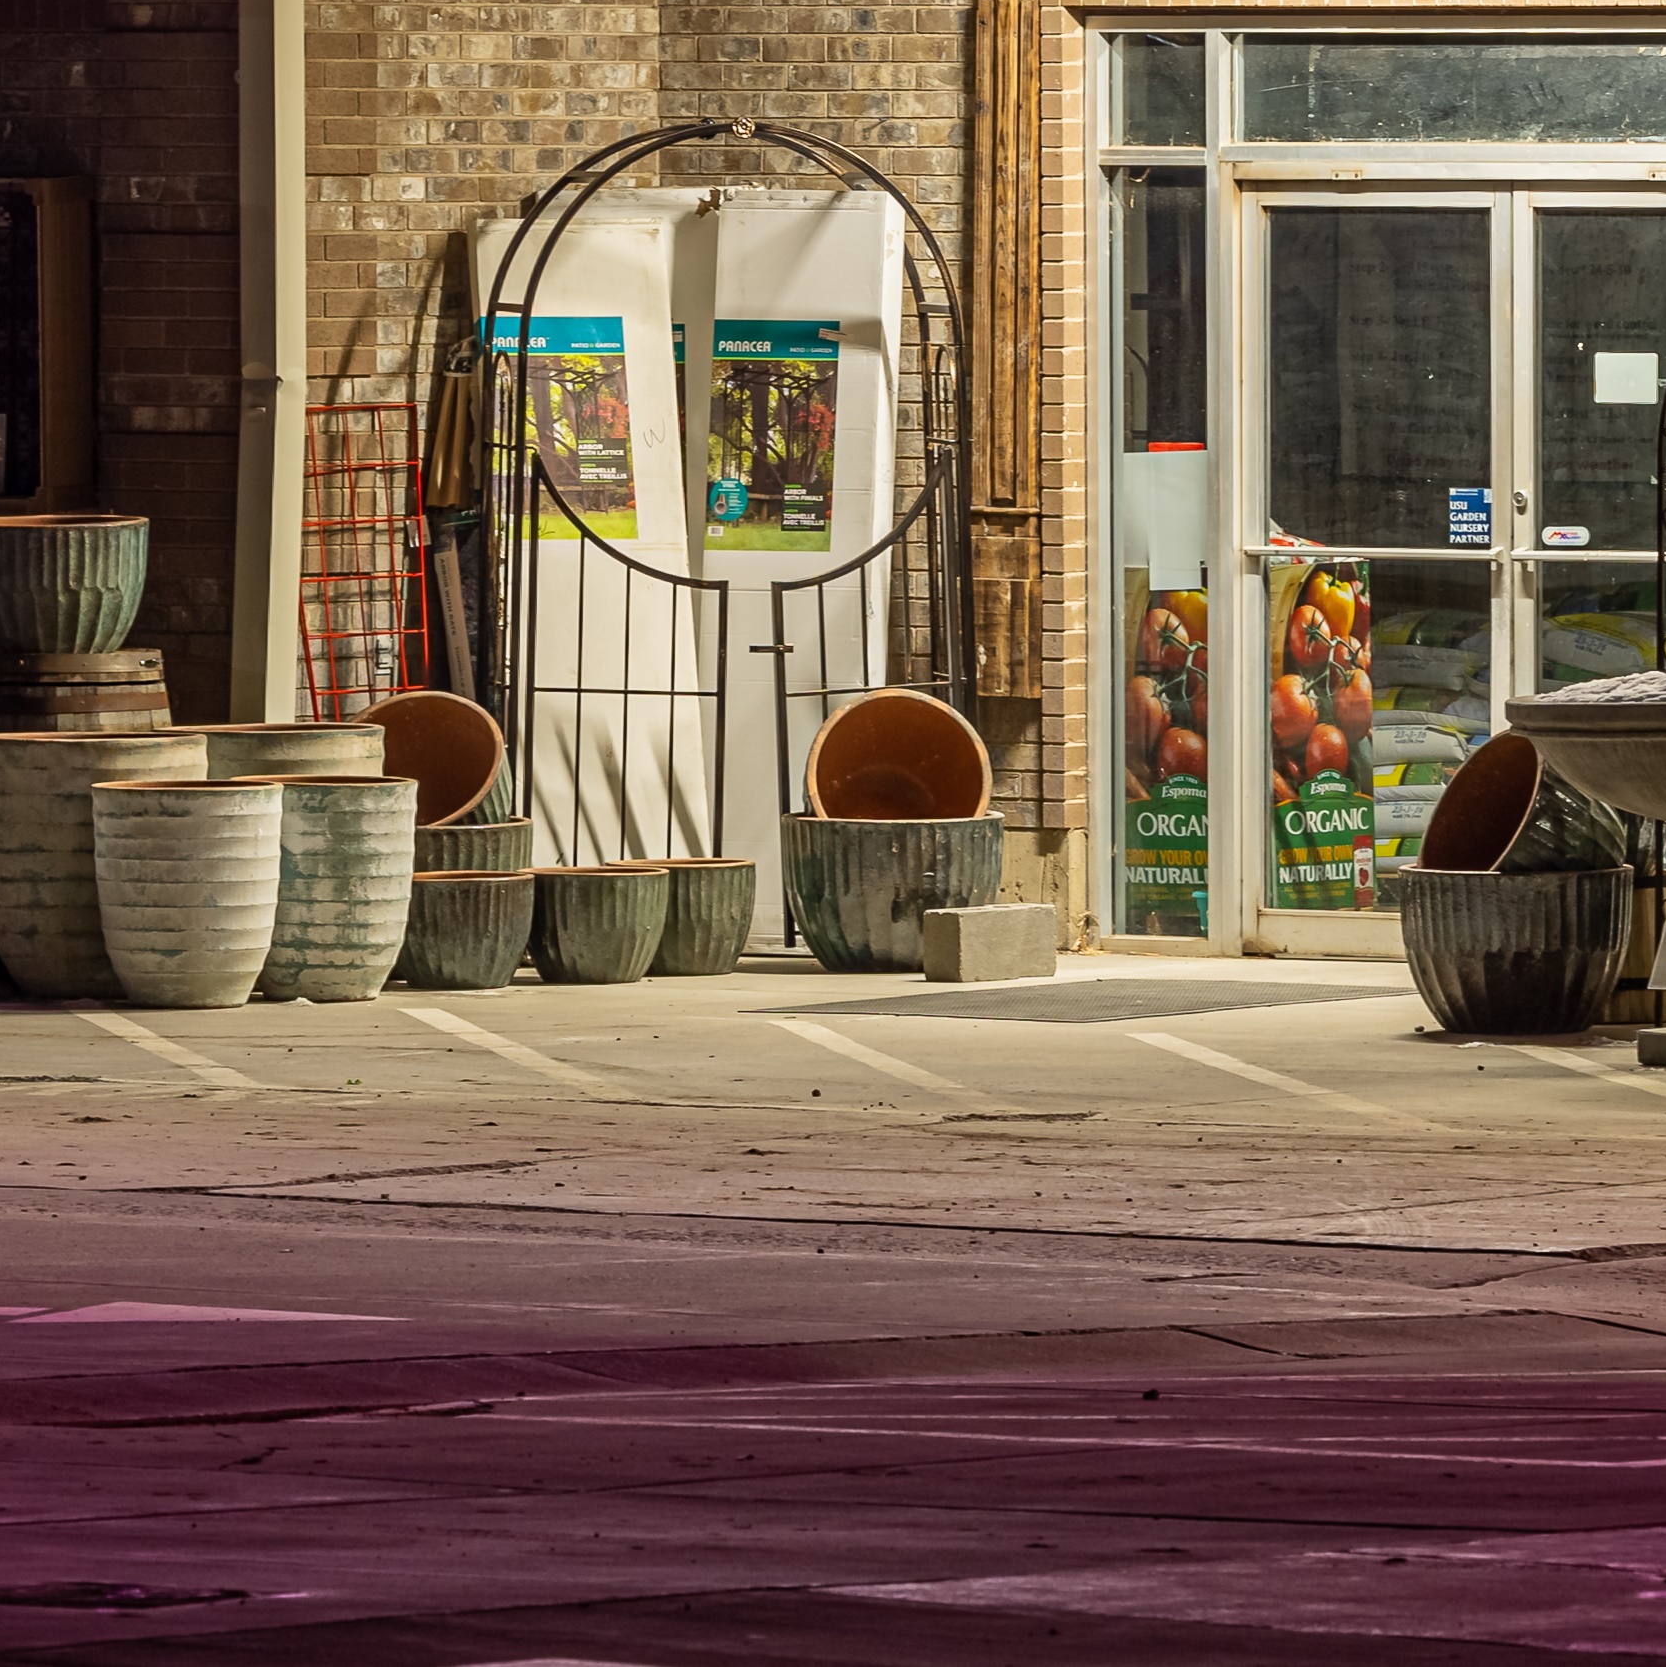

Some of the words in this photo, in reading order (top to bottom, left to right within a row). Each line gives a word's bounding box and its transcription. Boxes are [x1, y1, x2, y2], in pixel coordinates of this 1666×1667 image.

[718, 340, 772, 352] PANACEA
[1449, 501, 1468, 510] USU
[1449, 512, 1487, 521] GARDEN
[1449, 524, 1490, 533] NURSERY
[1449, 535, 1491, 544] PARTNER
[1161, 785, 1207, 799] Espoma
[1285, 807, 1370, 835] ORGANIC
[1159, 850, 1192, 865] YOUR
[1279, 862, 1353, 884] NATURALLY
